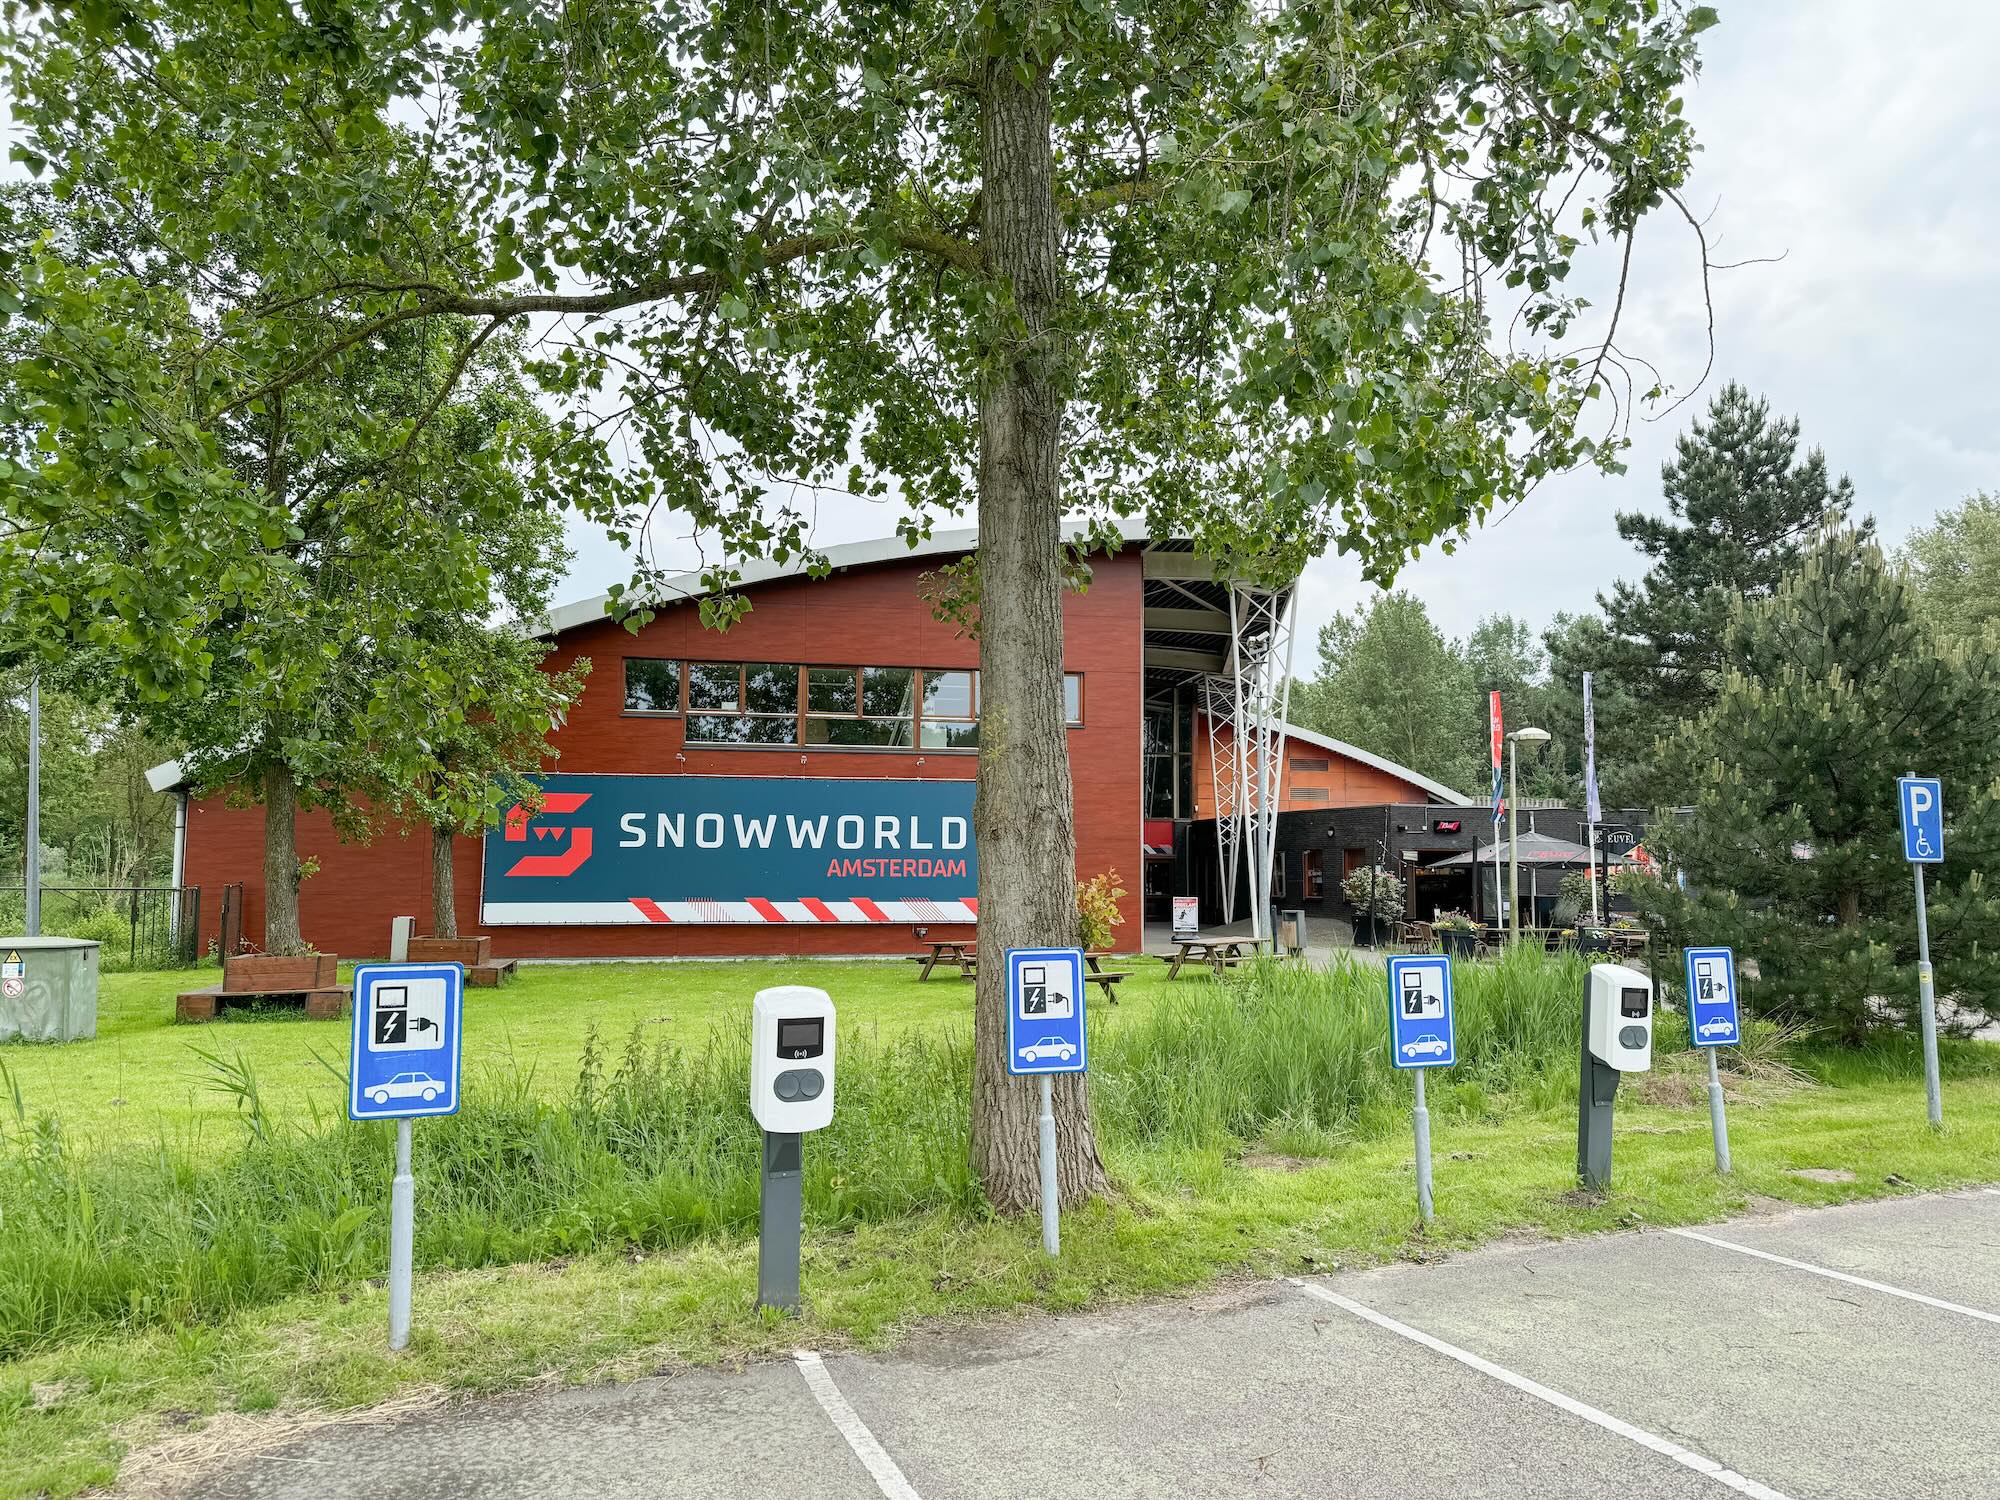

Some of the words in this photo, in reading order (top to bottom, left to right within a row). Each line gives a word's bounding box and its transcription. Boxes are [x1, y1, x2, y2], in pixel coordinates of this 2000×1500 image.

[1910, 786, 1932, 826] P
[619, 813, 967, 850] SNOWWORLD
[1605, 834, 1636, 845] EUVEL
[827, 858, 967, 878] AMSTERDAM
